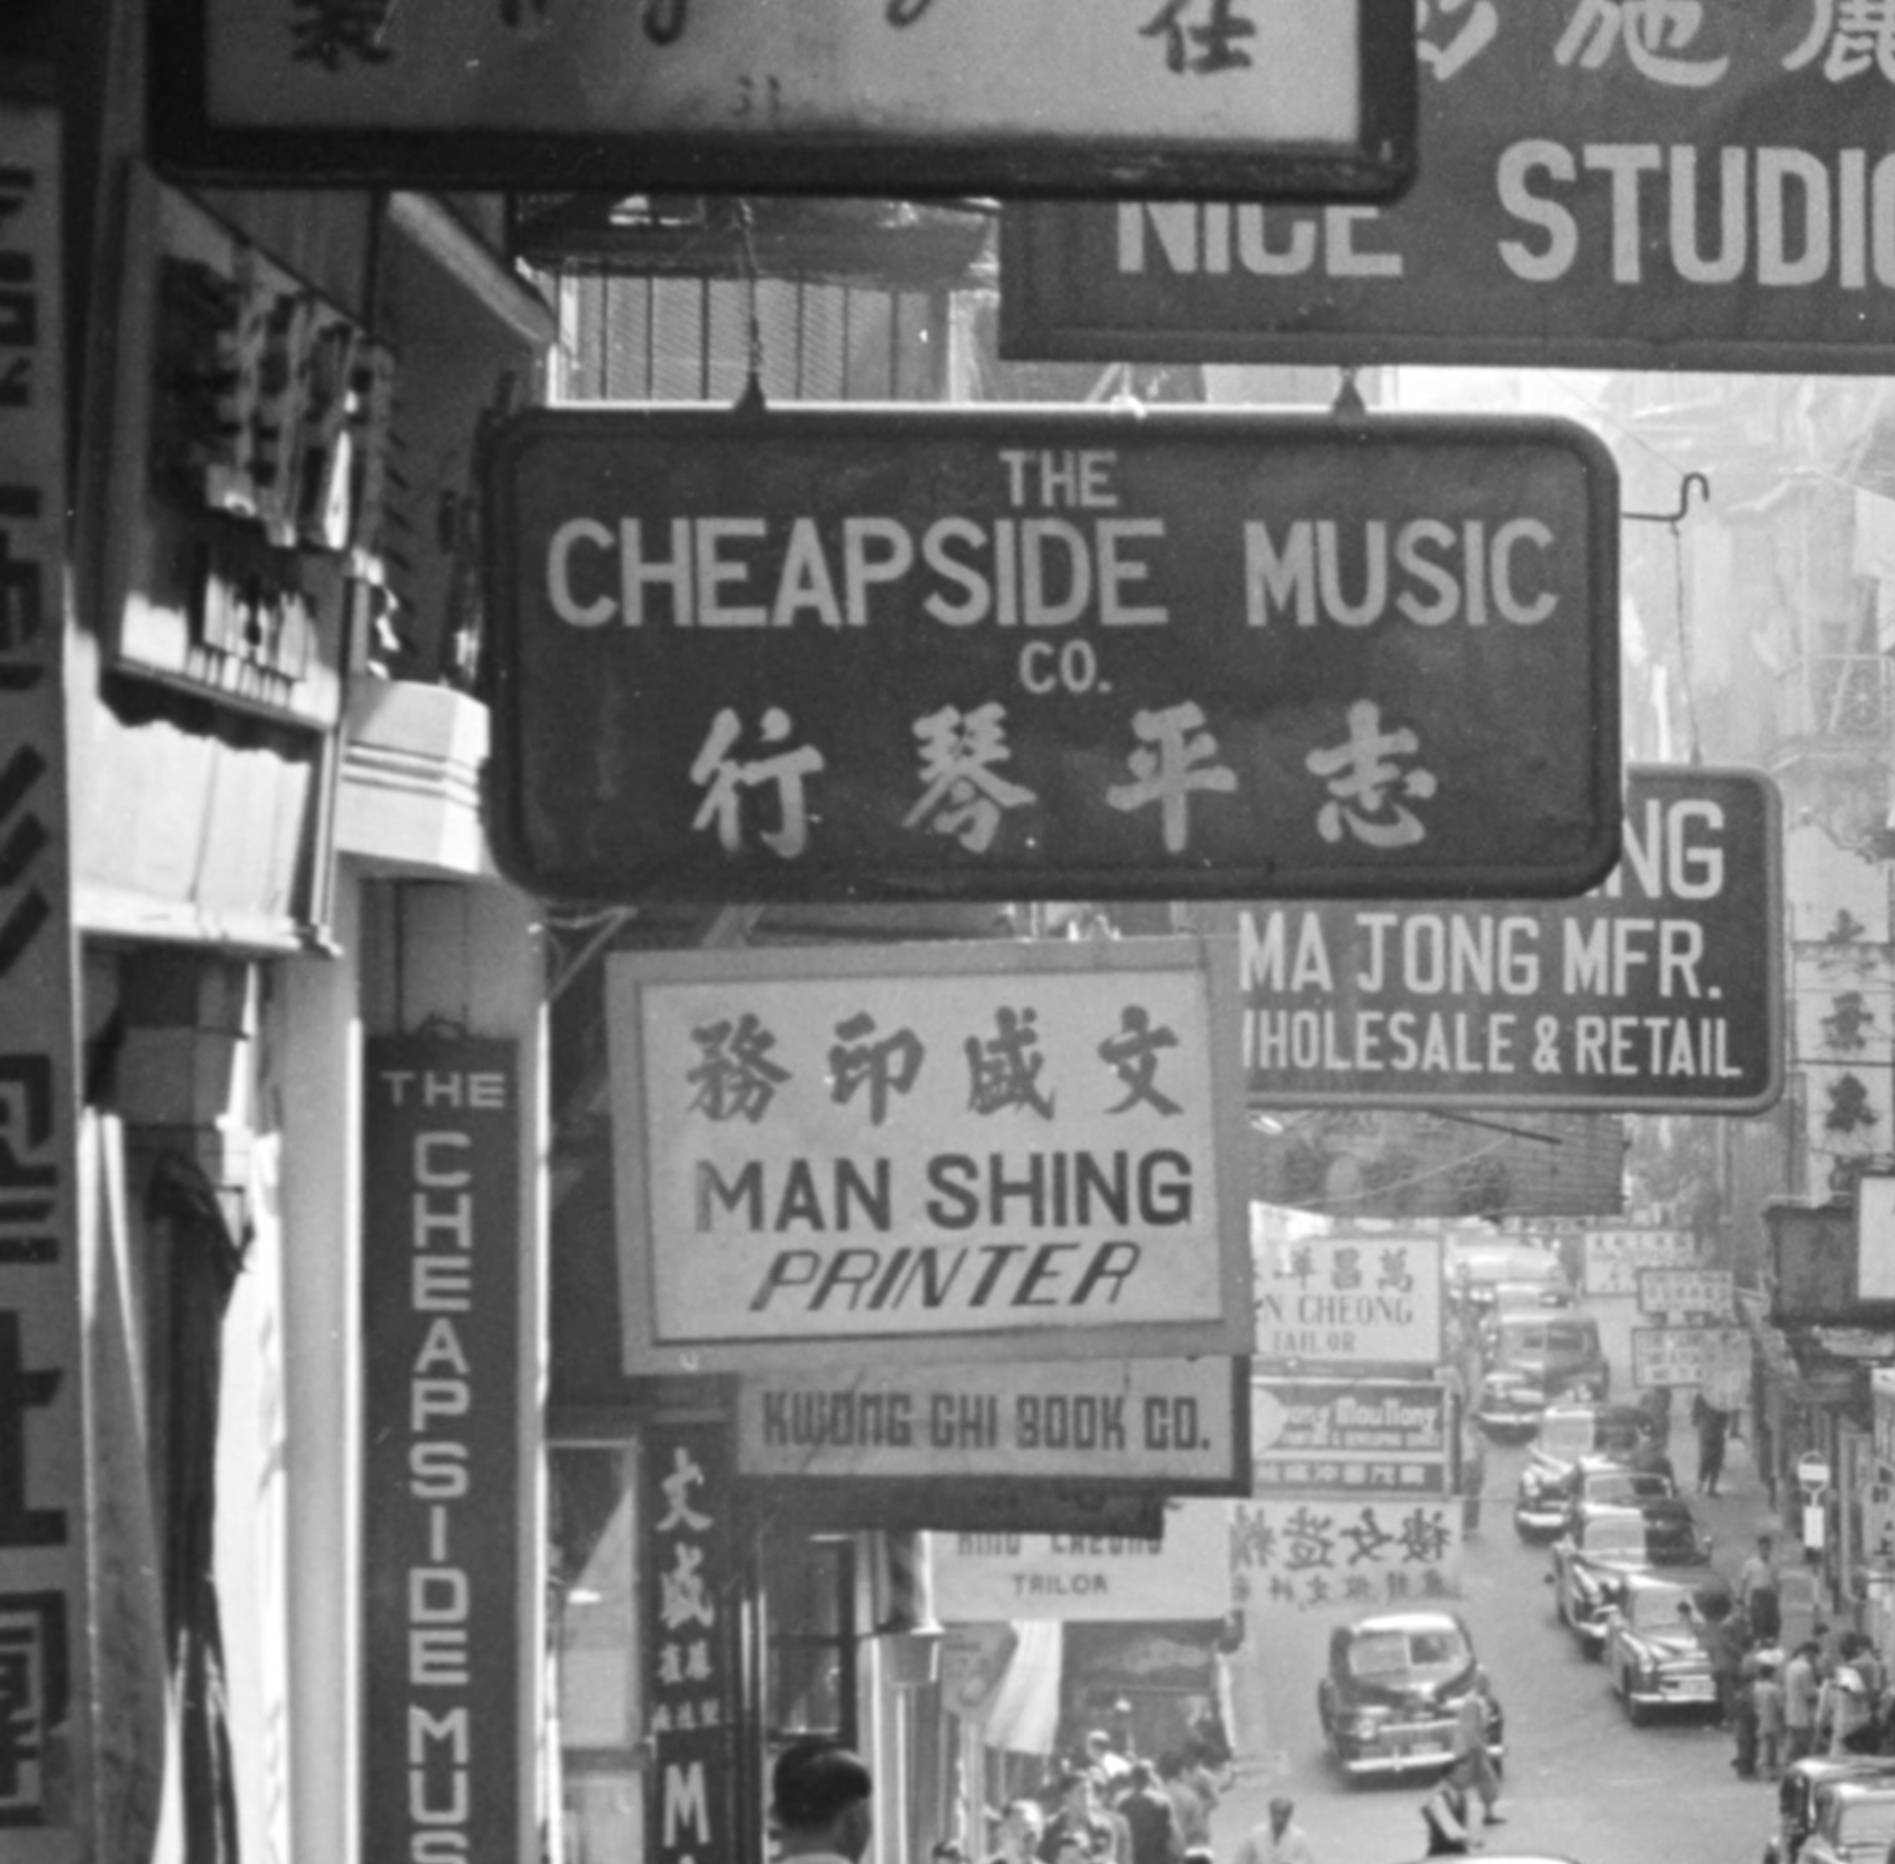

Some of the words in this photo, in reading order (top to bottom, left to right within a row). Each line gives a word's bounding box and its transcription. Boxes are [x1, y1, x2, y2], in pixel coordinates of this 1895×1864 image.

[1001, 450, 1118, 507] THE
[545, 516, 1168, 629] CHEAPSIDE
[1244, 518, 1559, 627] MUSIC
[1019, 639, 1112, 694] CO.
[1237, 910, 1335, 994] MA
[1355, 911, 1540, 996] JONG
[1562, 918, 1724, 1000] MFR.
[1532, 1018, 1563, 1072] &
[1576, 1015, 1743, 1080] RETAIL
[379, 1071, 507, 1108] THE
[694, 1158, 891, 1233] MAN
[926, 1149, 1194, 1229] SHING
[748, 1241, 1141, 1312] PRINTER
[408, 1132, 472, 1686] CHEAPSIDE
[763, 1390, 911, 1448] KWONG
[931, 1394, 996, 1449] CHI
[1016, 1395, 1126, 1451] BOOK
[1144, 1395, 1210, 1451] CO.
